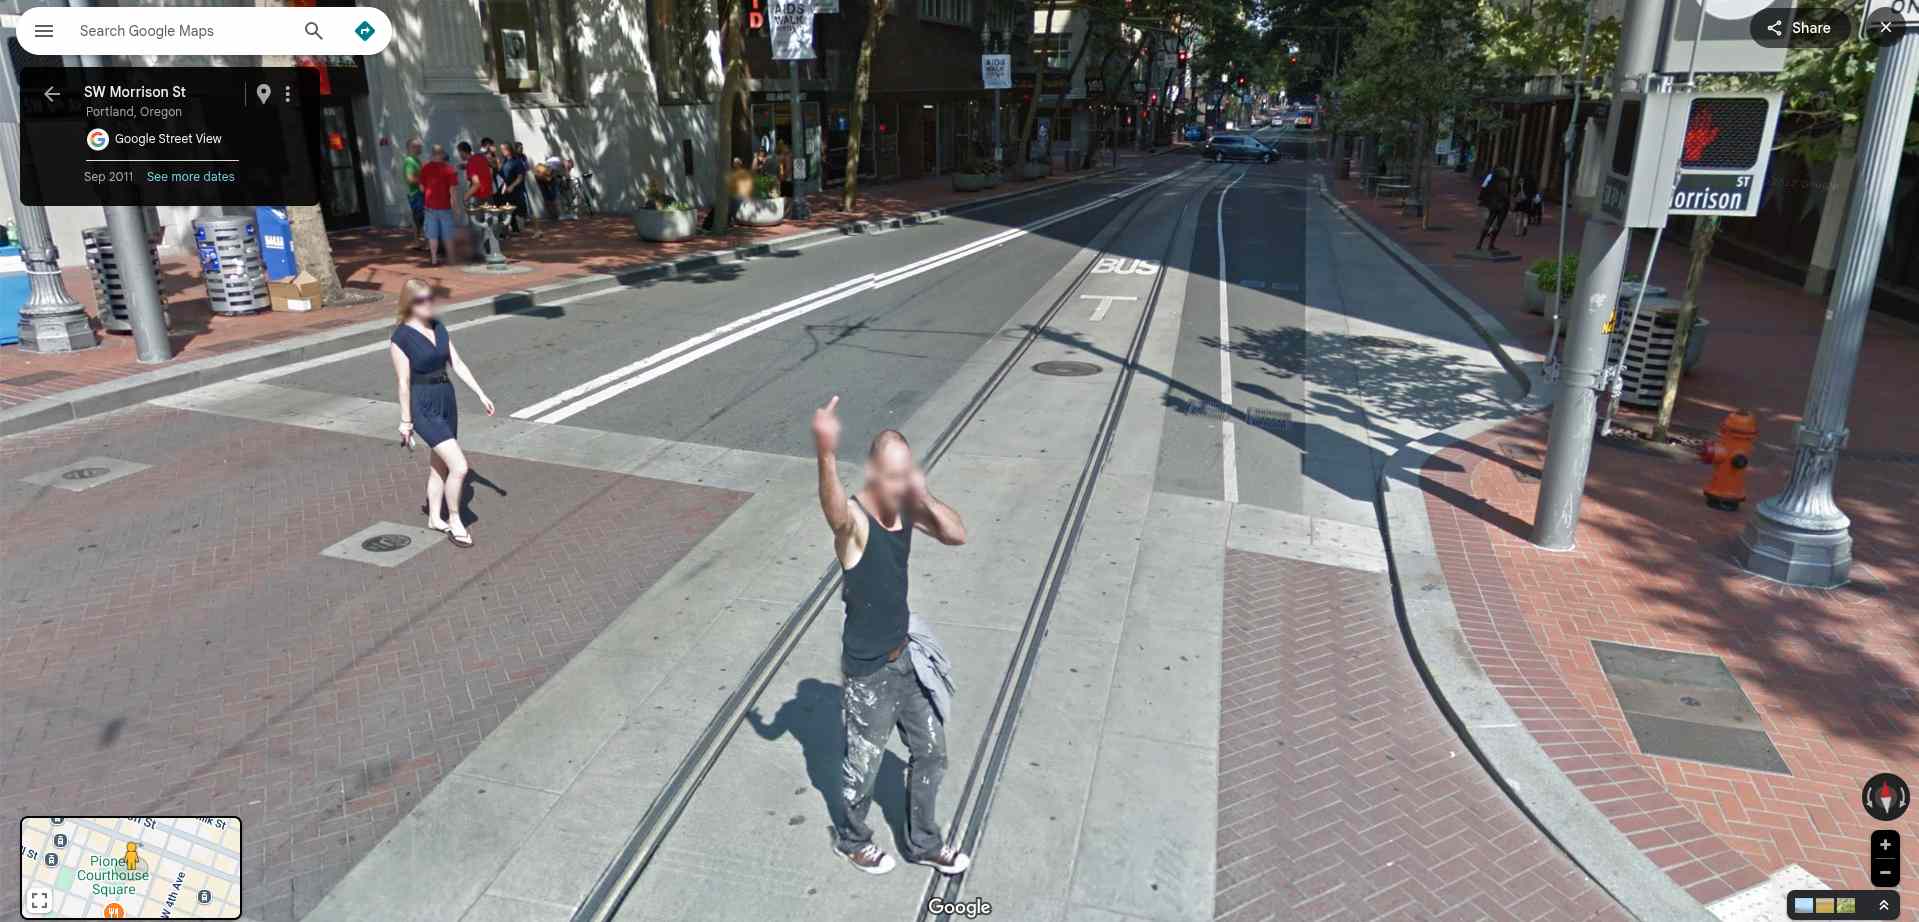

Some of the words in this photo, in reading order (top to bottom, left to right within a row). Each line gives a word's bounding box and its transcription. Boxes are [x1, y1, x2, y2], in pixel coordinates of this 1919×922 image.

[775, 3, 805, 15] AIDS
[775, 15, 805, 25] WALK
[1736, 176, 1751, 188] ST
[1091, 258, 1160, 275] BUS
